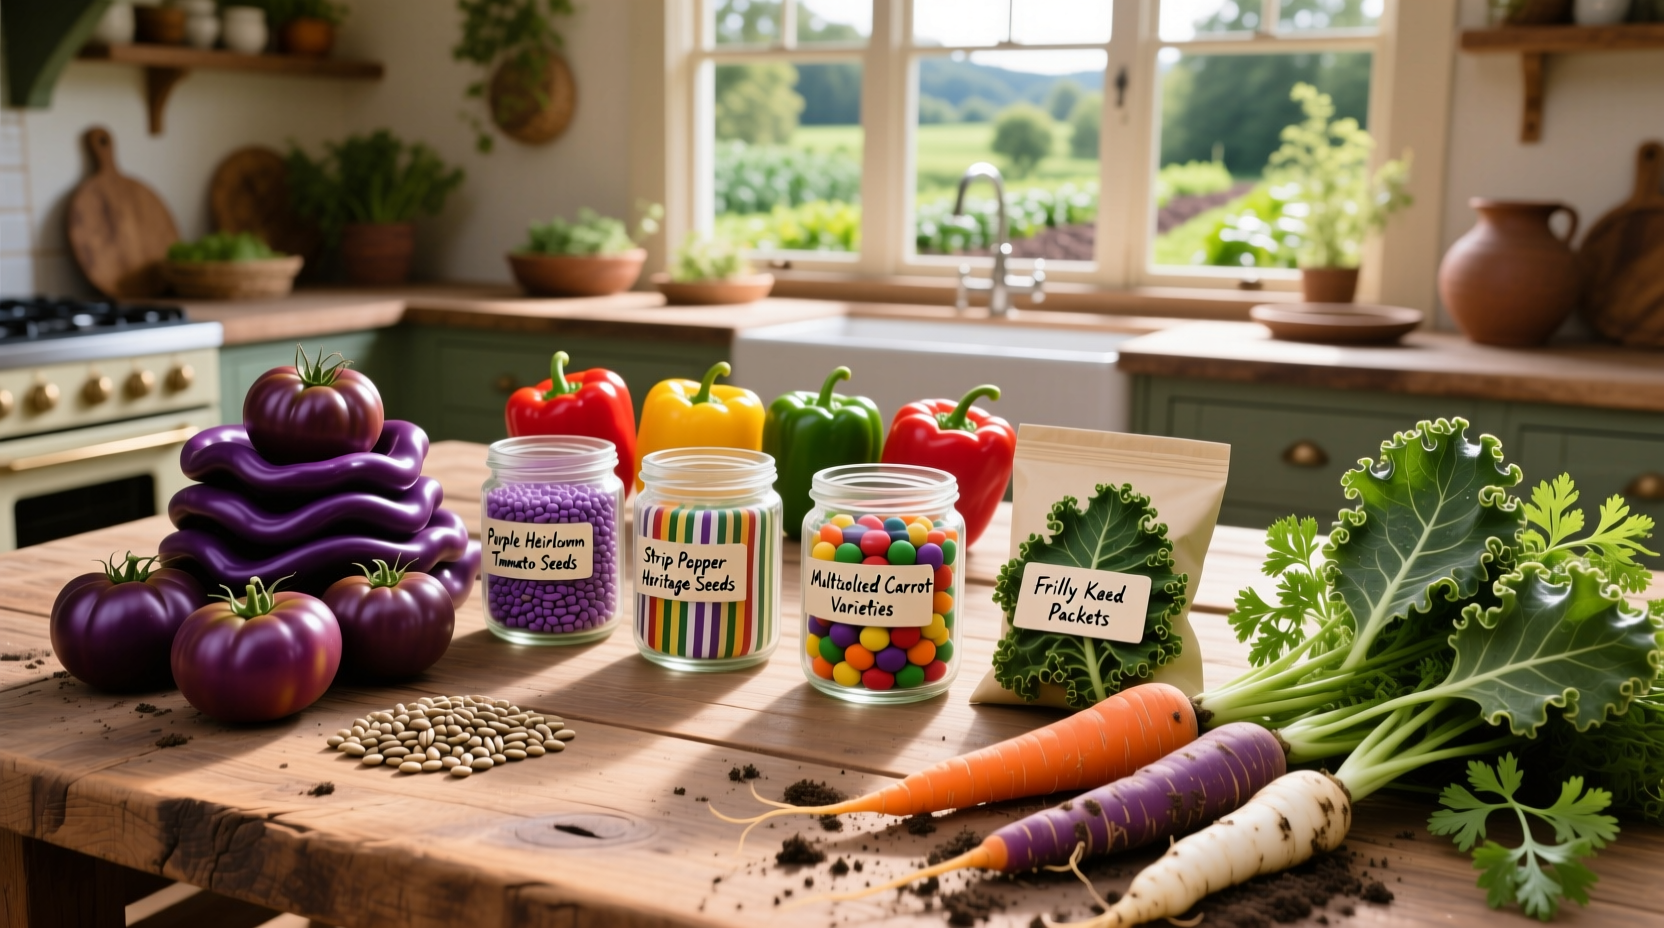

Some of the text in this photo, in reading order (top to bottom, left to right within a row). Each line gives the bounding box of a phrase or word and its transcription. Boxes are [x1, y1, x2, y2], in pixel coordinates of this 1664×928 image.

[488, 527, 521, 552] Purple
[540, 554, 577, 571] Seeds
[643, 546, 674, 571] Strip
[695, 574, 735, 592] Seeds
[884, 575, 933, 594] Carrot
[1034, 576, 1078, 604] Frilly
[831, 596, 893, 617] Varieties
[1048, 602, 1110, 627] Packets
